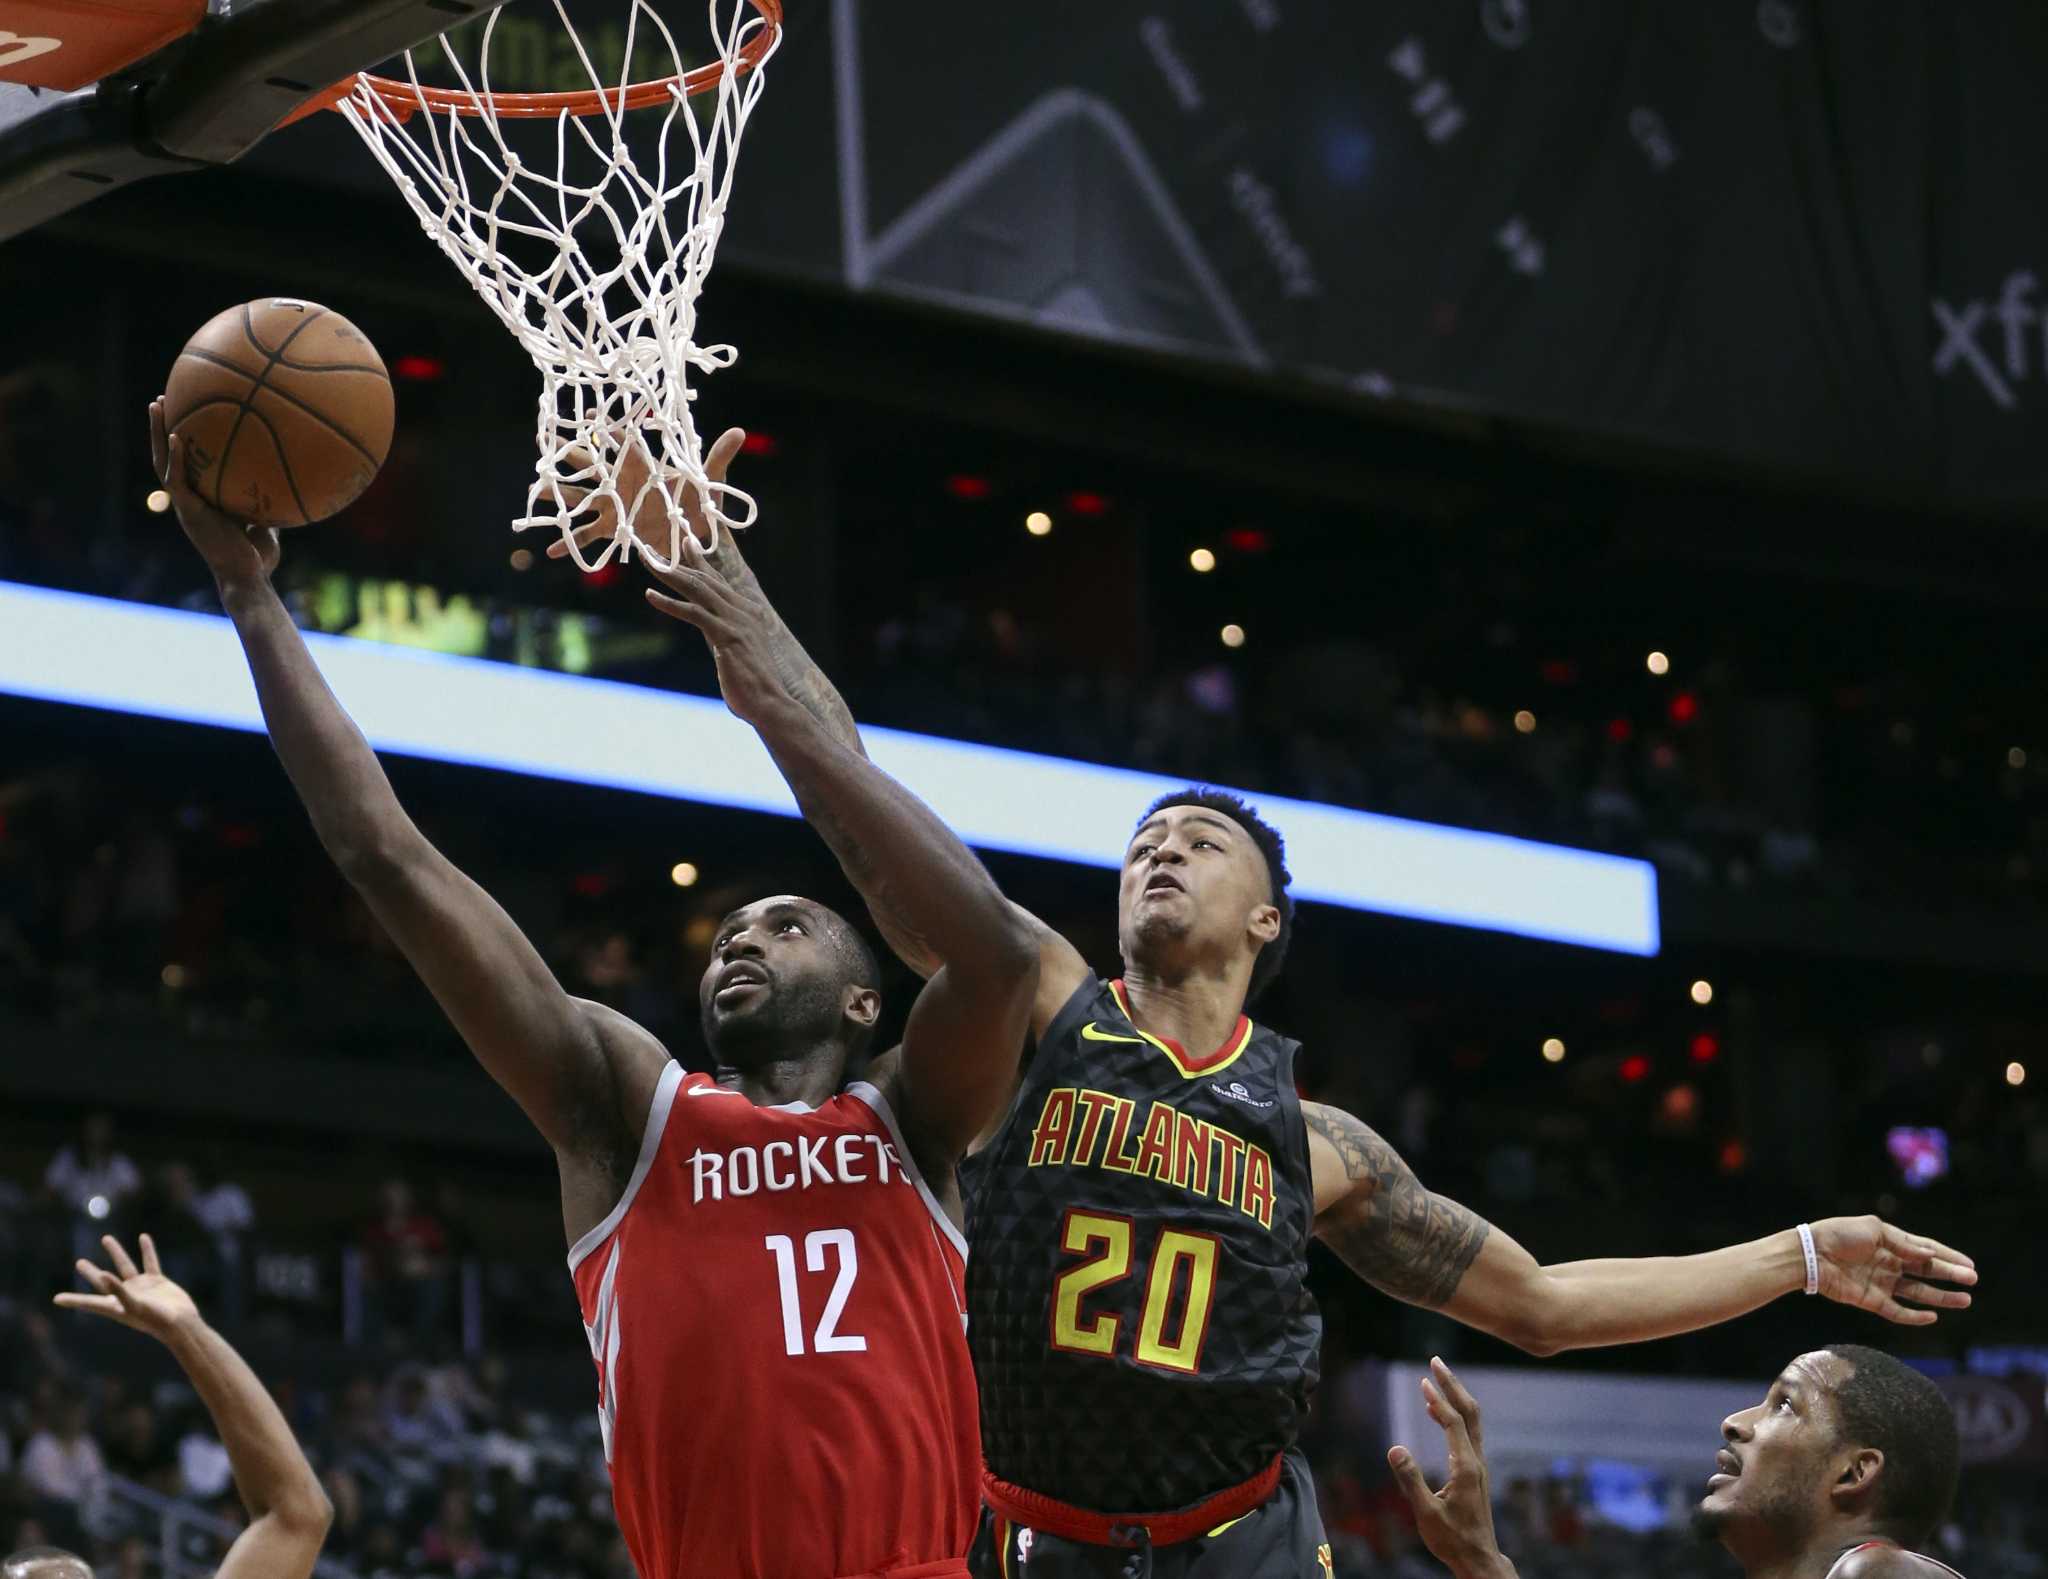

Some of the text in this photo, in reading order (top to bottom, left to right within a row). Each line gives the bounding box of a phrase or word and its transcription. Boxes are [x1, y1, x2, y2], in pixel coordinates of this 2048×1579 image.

[683, 1133, 913, 1206] ROCKETS
[1027, 1087, 1277, 1232] ATLANTA
[764, 1227, 868, 1357] 12
[1050, 1206, 1221, 1376] 20
